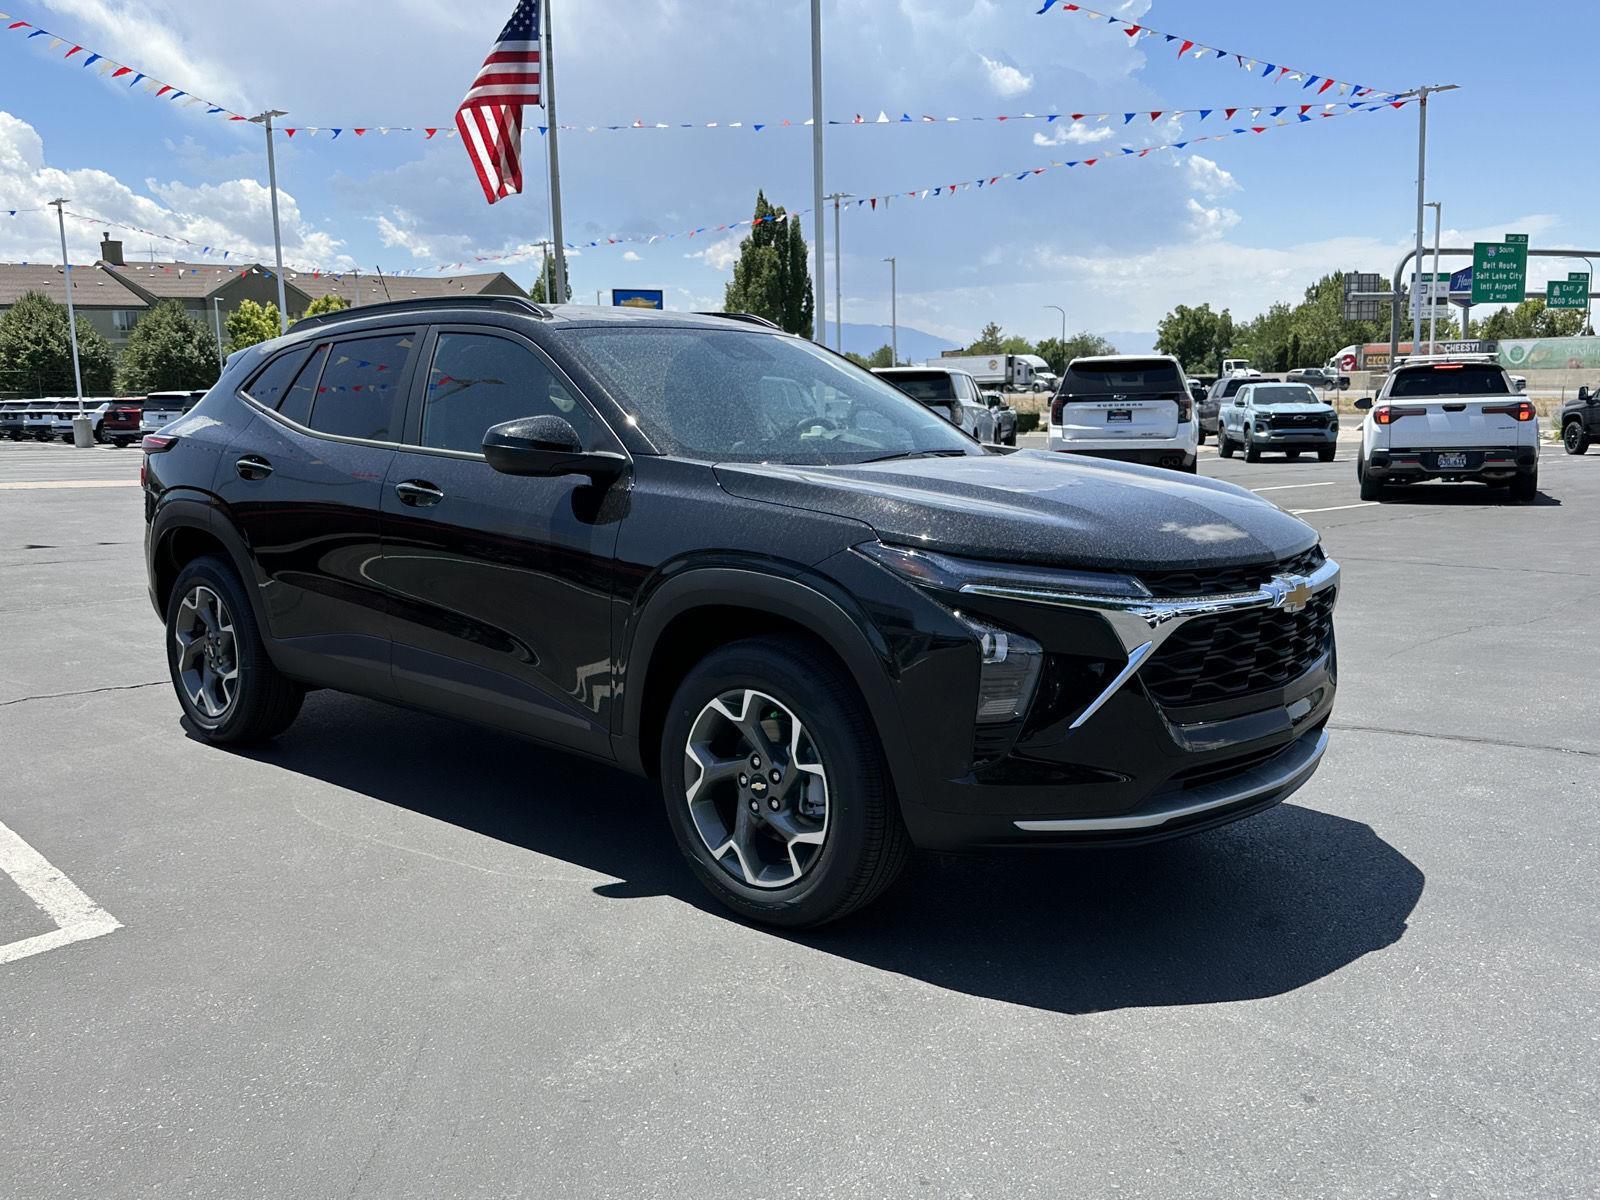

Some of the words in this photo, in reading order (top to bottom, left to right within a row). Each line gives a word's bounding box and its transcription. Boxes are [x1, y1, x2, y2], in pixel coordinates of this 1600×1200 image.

[1491, 272, 1507, 280] Lake
[1509, 272, 1523, 281] City
[1495, 283, 1517, 291] Airport
[1550, 297, 1565, 305] 2600
[1568, 297, 1585, 305] South
[1444, 343, 1480, 353] CHEESY!
